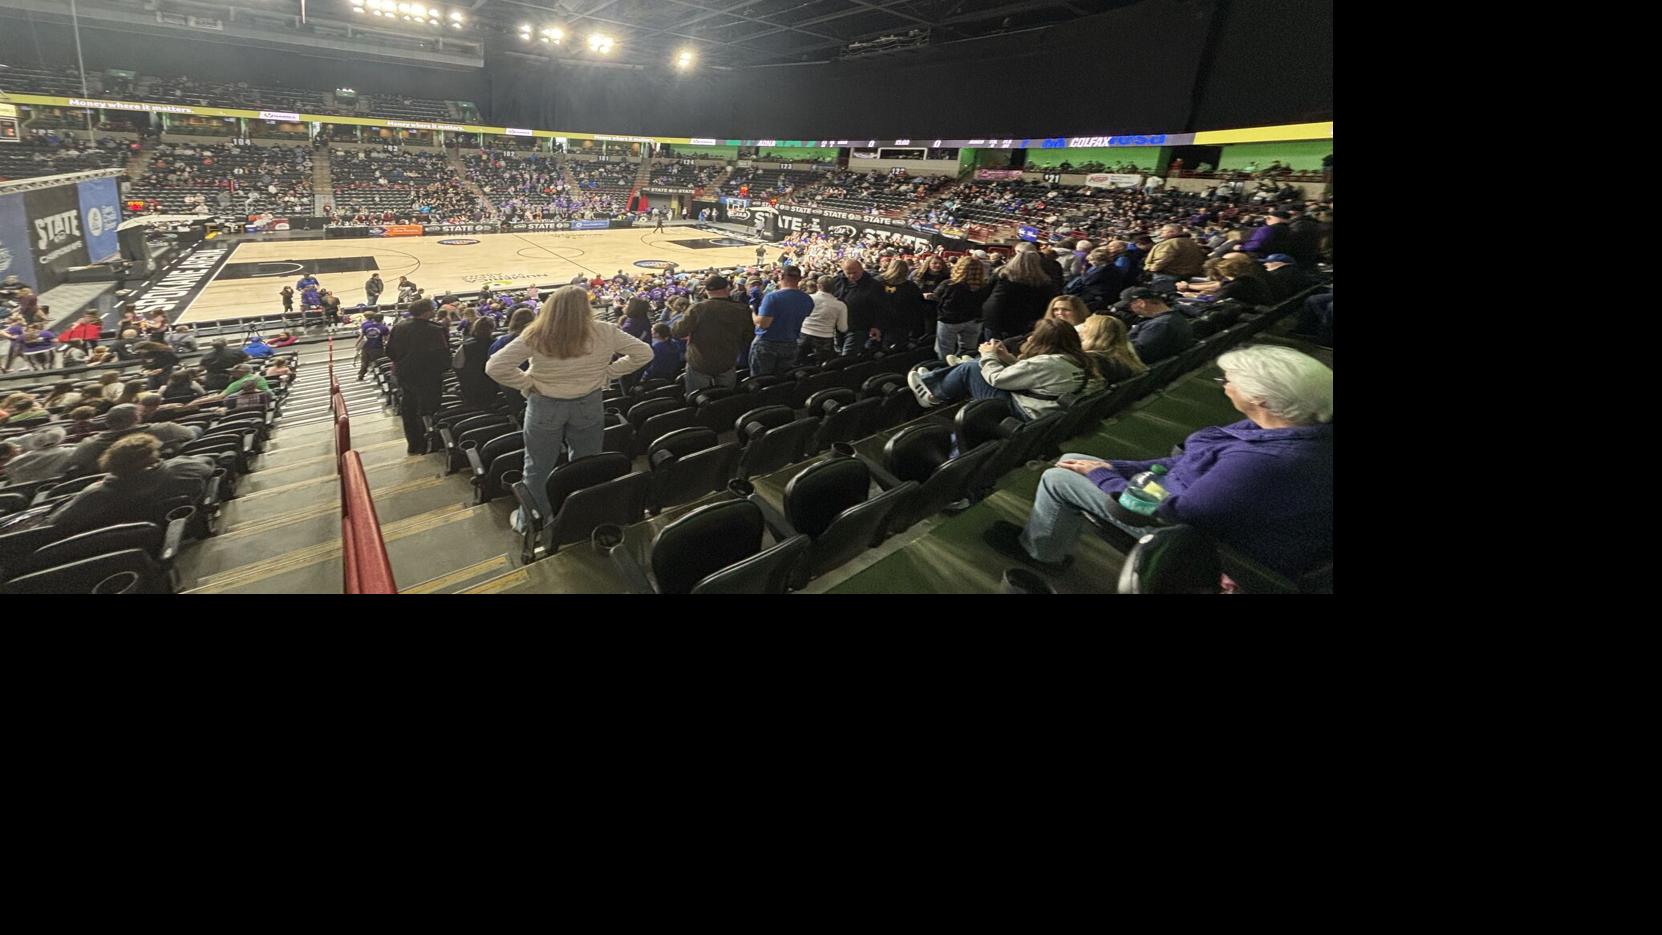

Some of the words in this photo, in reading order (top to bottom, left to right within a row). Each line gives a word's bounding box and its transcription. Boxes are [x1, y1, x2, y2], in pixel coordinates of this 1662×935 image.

[69, 99, 107, 108] Money
[108, 101, 142, 110] where
[1069, 136, 1112, 147] COLFAX
[790, 206, 812, 214] STATE
[823, 210, 848, 219] STATE
[863, 215, 891, 225] STATE
[34, 209, 81, 250] STATE
[134, 268, 210, 313] SPOKANE
